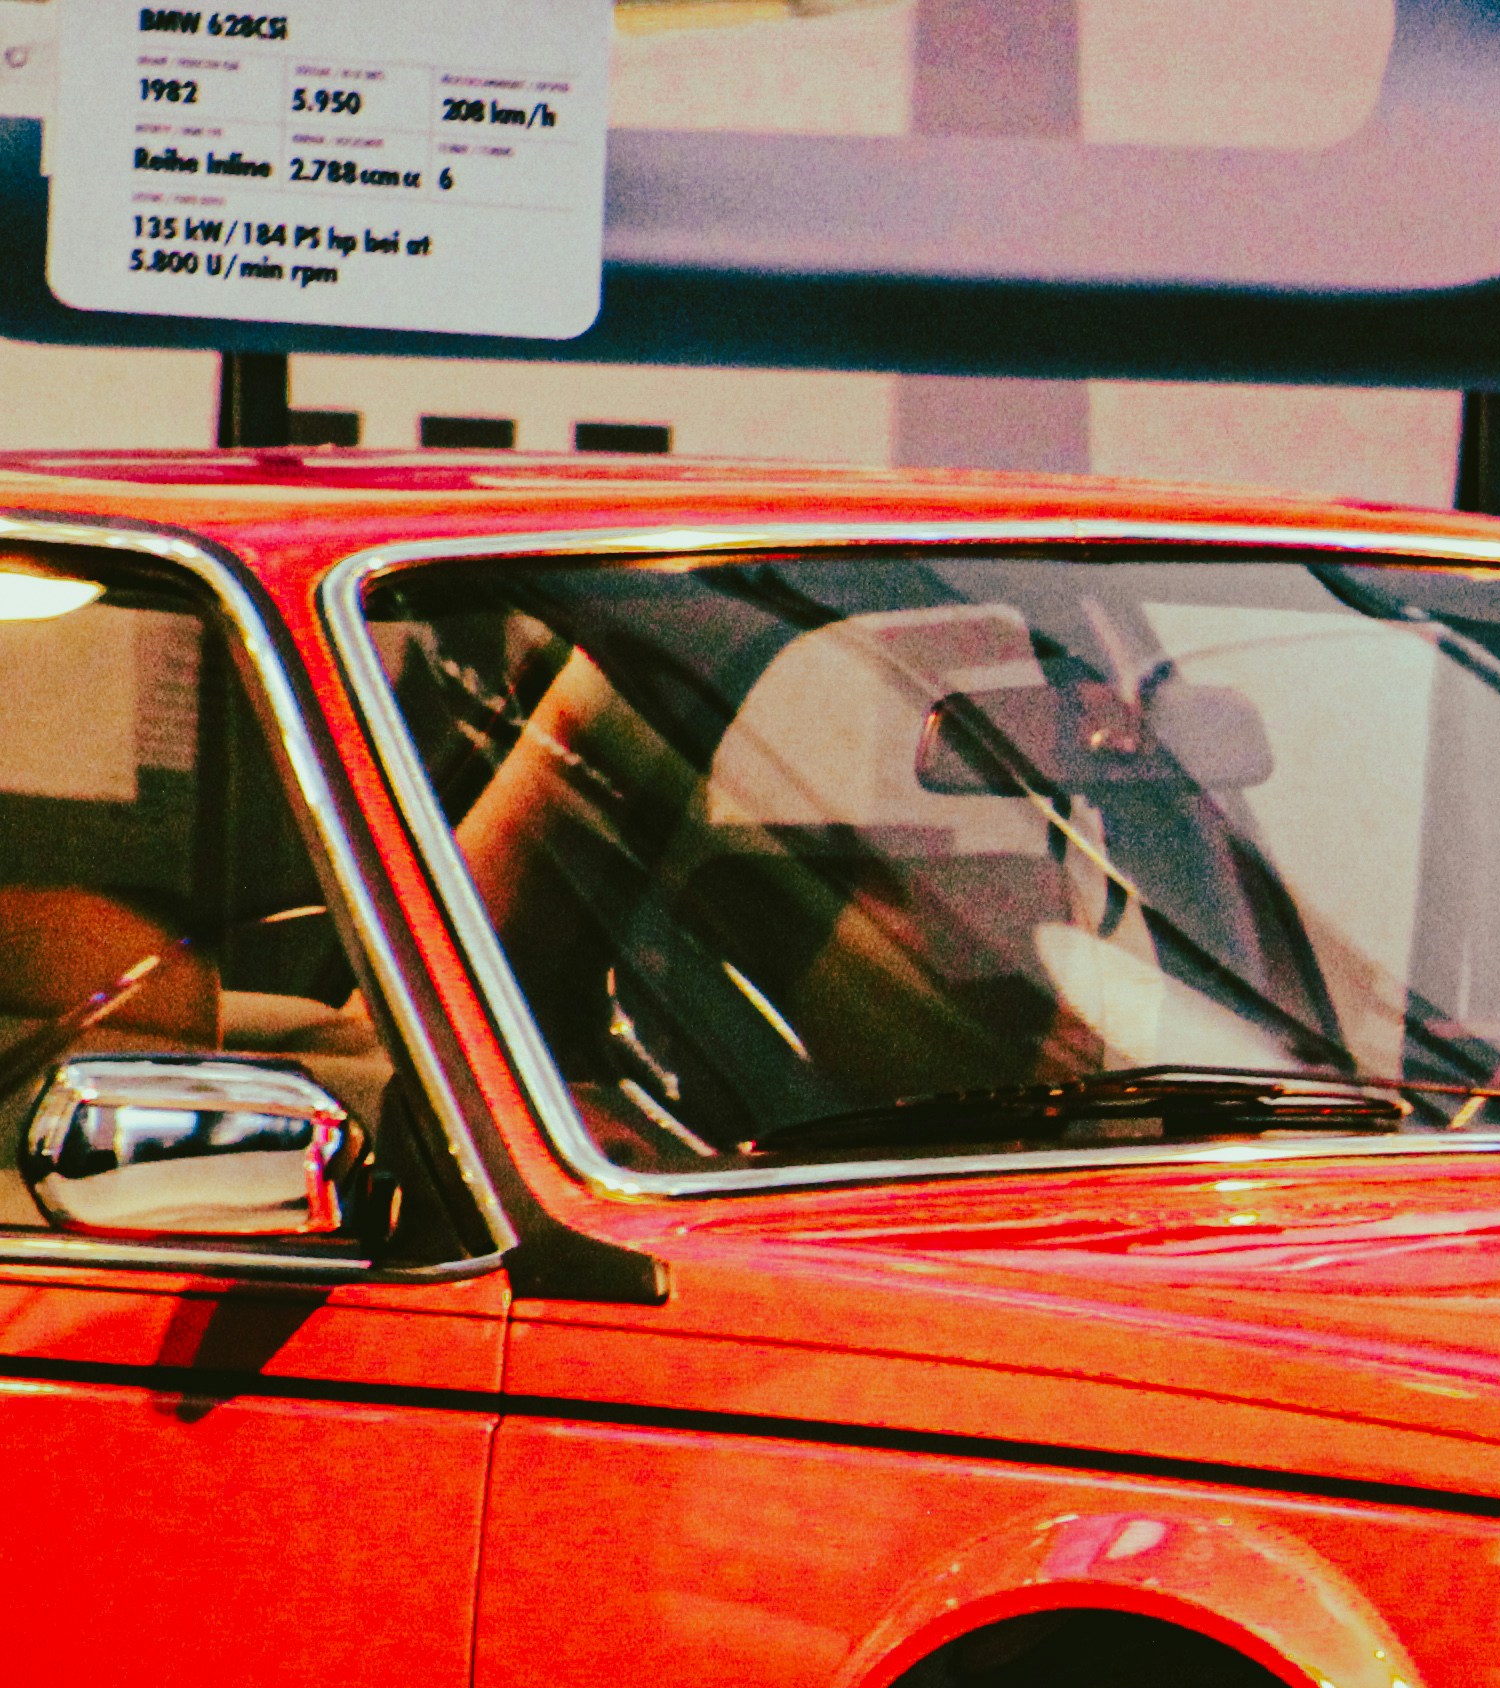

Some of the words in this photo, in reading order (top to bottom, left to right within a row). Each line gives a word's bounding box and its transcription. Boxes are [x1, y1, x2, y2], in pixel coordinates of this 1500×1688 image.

[139, 8, 201, 34] BMW
[207, 12, 288, 40] 628CSi
[140, 77, 198, 104] 1982
[292, 87, 362, 115] 5.950
[441, 98, 485, 123] 208
[490, 101, 557, 129] km/h
[134, 148, 199, 174] Reihe
[207, 151, 272, 179] Inline
[290, 157, 357, 183] 2.788
[438, 167, 453, 190] 6
[133, 215, 178, 240] 135
[294, 225, 320, 249] PS
[328, 226, 357, 257] hp
[364, 228, 400, 253] bei
[406, 236, 431, 256] at
[129, 249, 199, 275] 5.800
[291, 265, 338, 288] rpm
